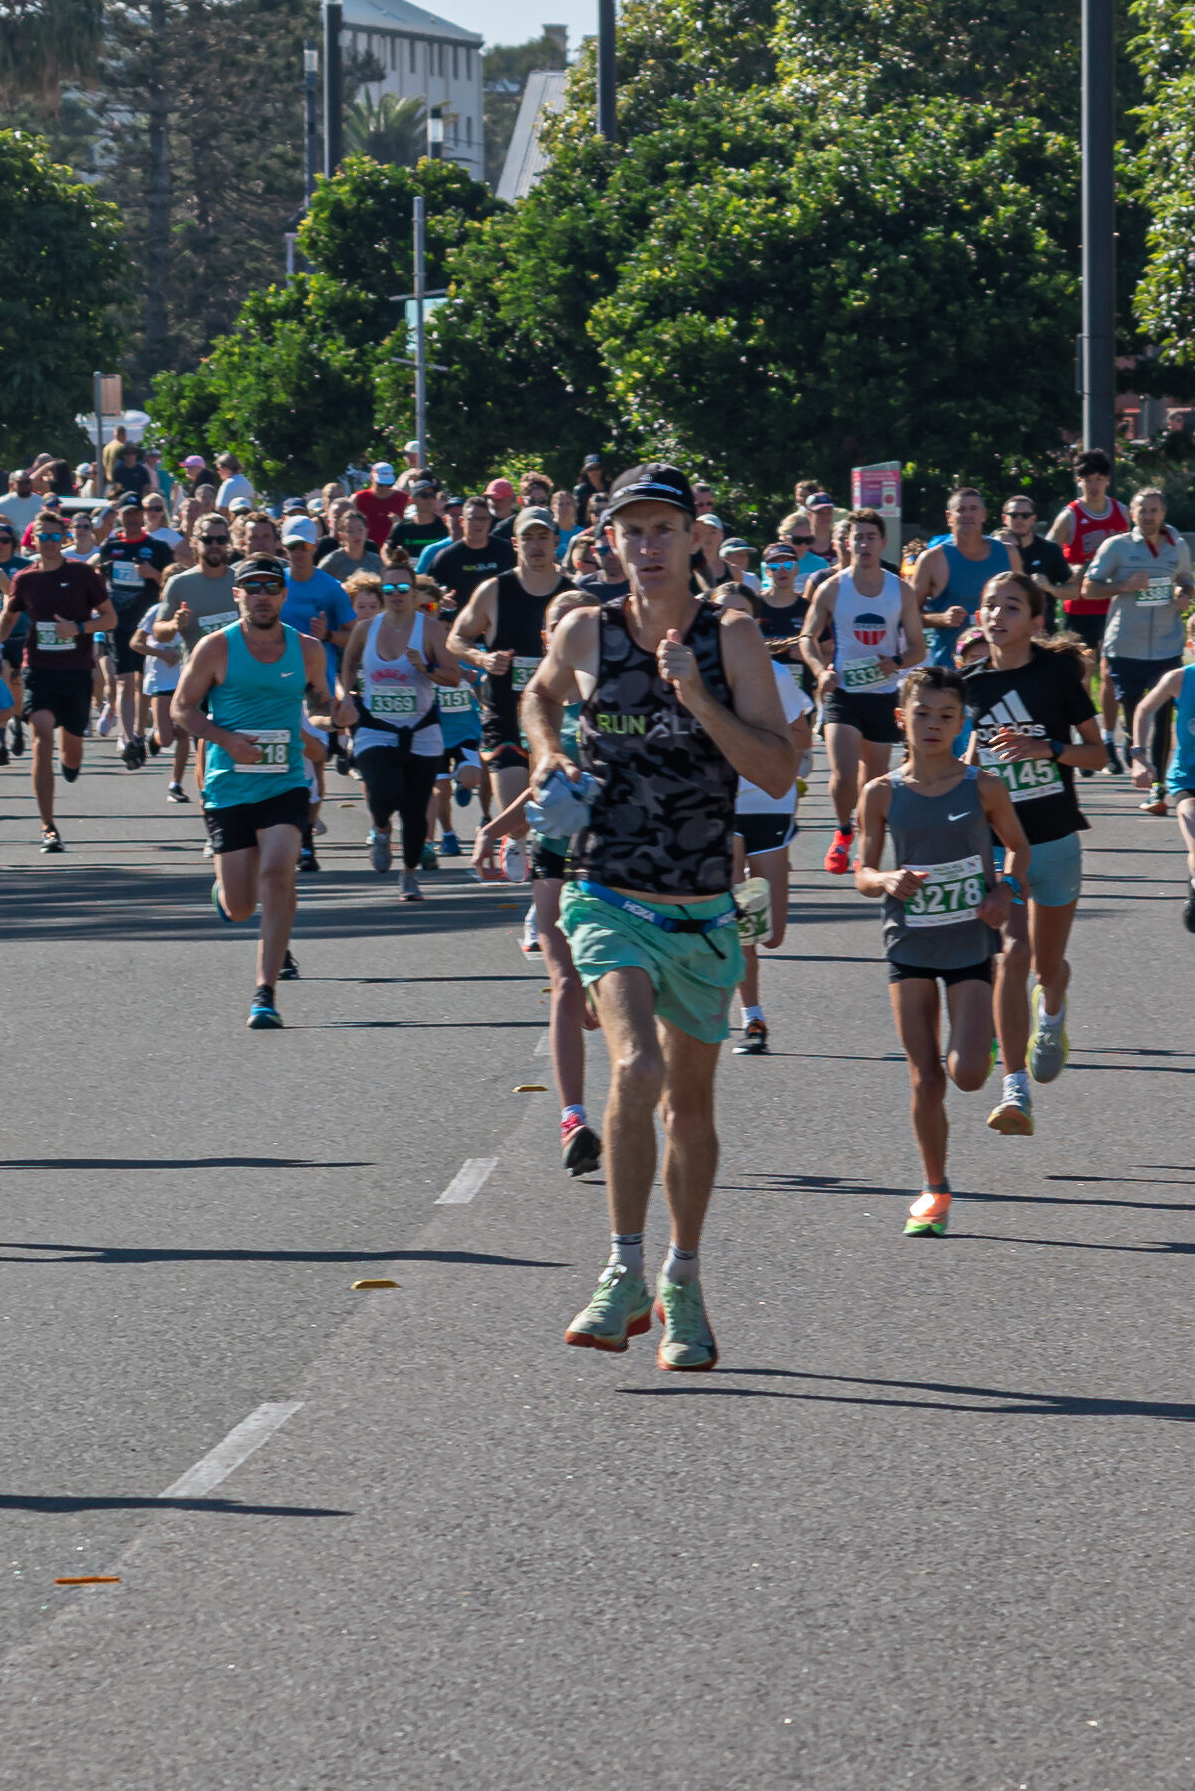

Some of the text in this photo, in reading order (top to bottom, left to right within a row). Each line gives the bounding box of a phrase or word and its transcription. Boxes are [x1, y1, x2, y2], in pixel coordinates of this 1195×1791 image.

[373, 696, 414, 712] 3369
[596, 713, 646, 735] RUN
[909, 878, 983, 914] 3278
